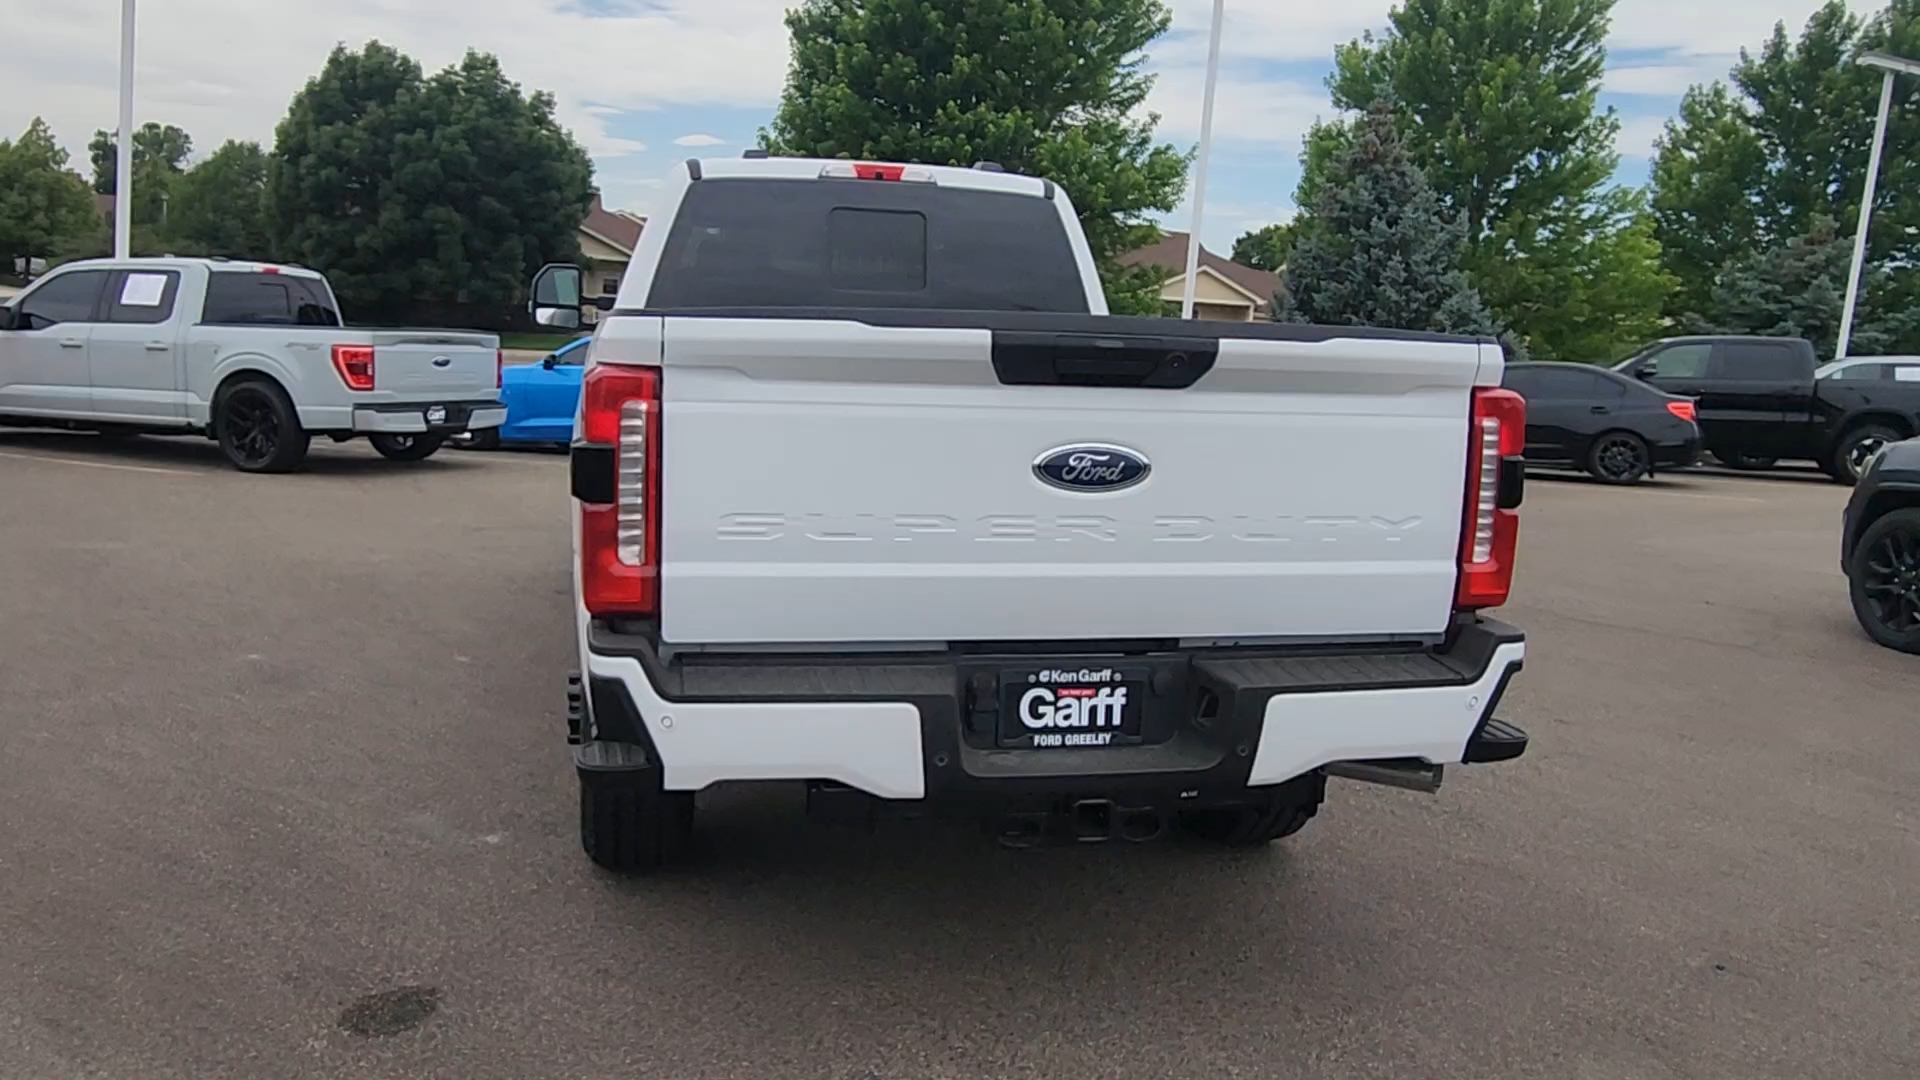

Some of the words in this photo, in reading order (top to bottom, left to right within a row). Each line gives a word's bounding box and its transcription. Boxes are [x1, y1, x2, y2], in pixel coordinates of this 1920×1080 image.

[1062, 452, 1124, 482] Ford
[717, 512, 1117, 542] SUPER
[1152, 514, 1424, 542] DUTY
[1051, 669, 1077, 683] Ken
[1078, 669, 1112, 682] Garff
[1019, 687, 1127, 729] Garff
[1033, 734, 1062, 747] FORD
[1064, 732, 1112, 745] GREELEY
